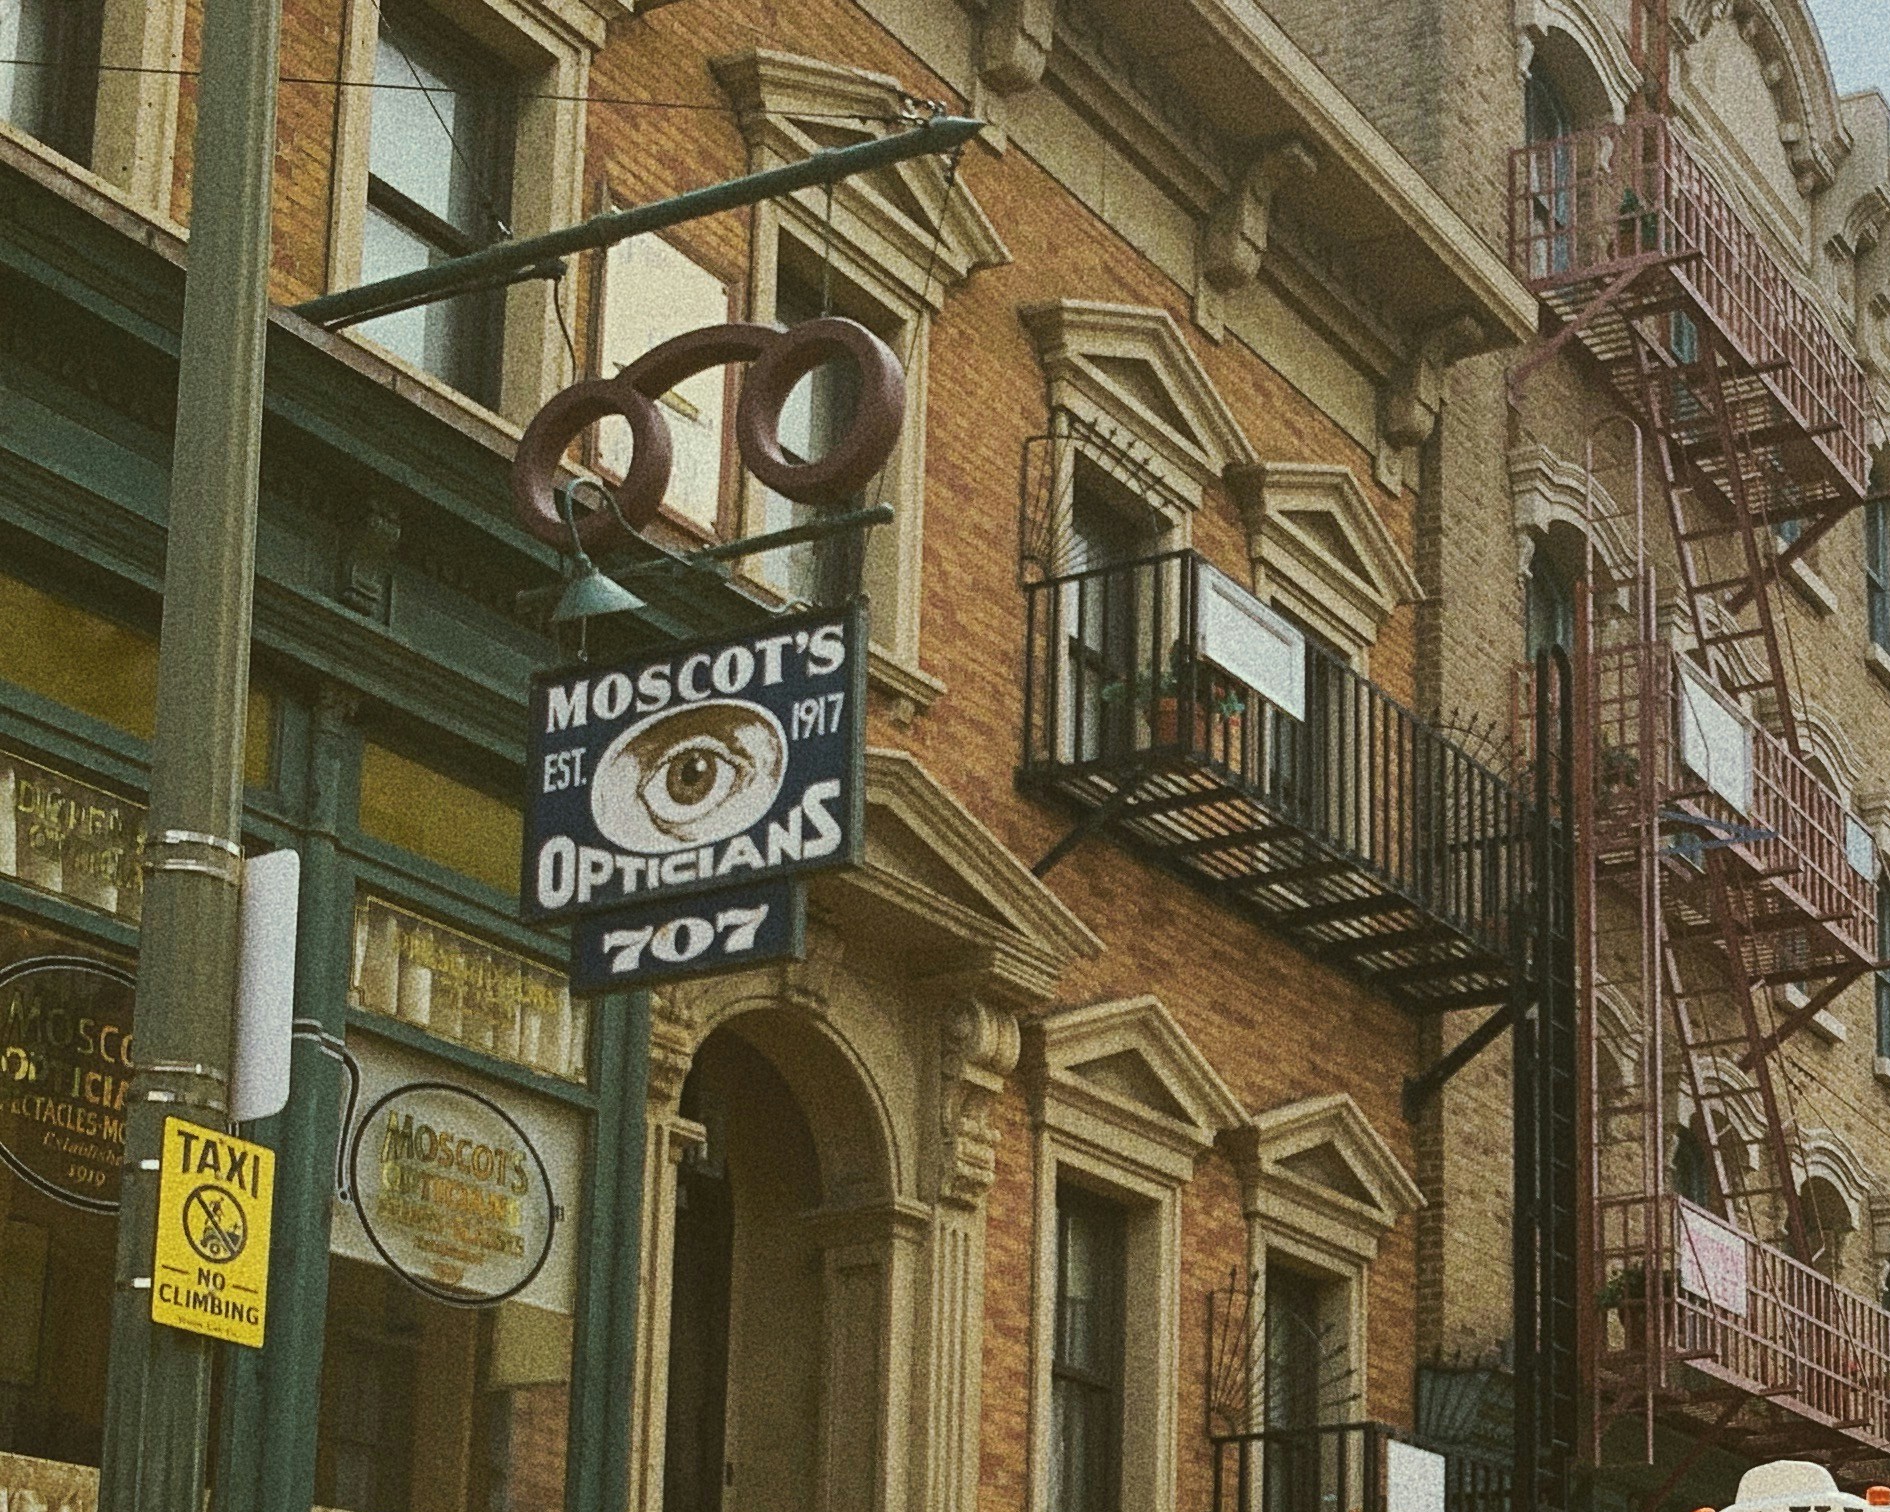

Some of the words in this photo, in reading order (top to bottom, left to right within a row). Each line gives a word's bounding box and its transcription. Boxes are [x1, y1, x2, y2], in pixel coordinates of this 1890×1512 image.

[545, 624, 846, 734] MOSCOT'S
[543, 747, 588, 793] EST.
[790, 692, 846, 741] 1917
[537, 779, 842, 910] OPTICIANS
[603, 903, 769, 974] 707
[177, 1129, 260, 1200] TAXI
[159, 1283, 259, 1326] CLIMBING
[197, 1267, 226, 1292] NO
